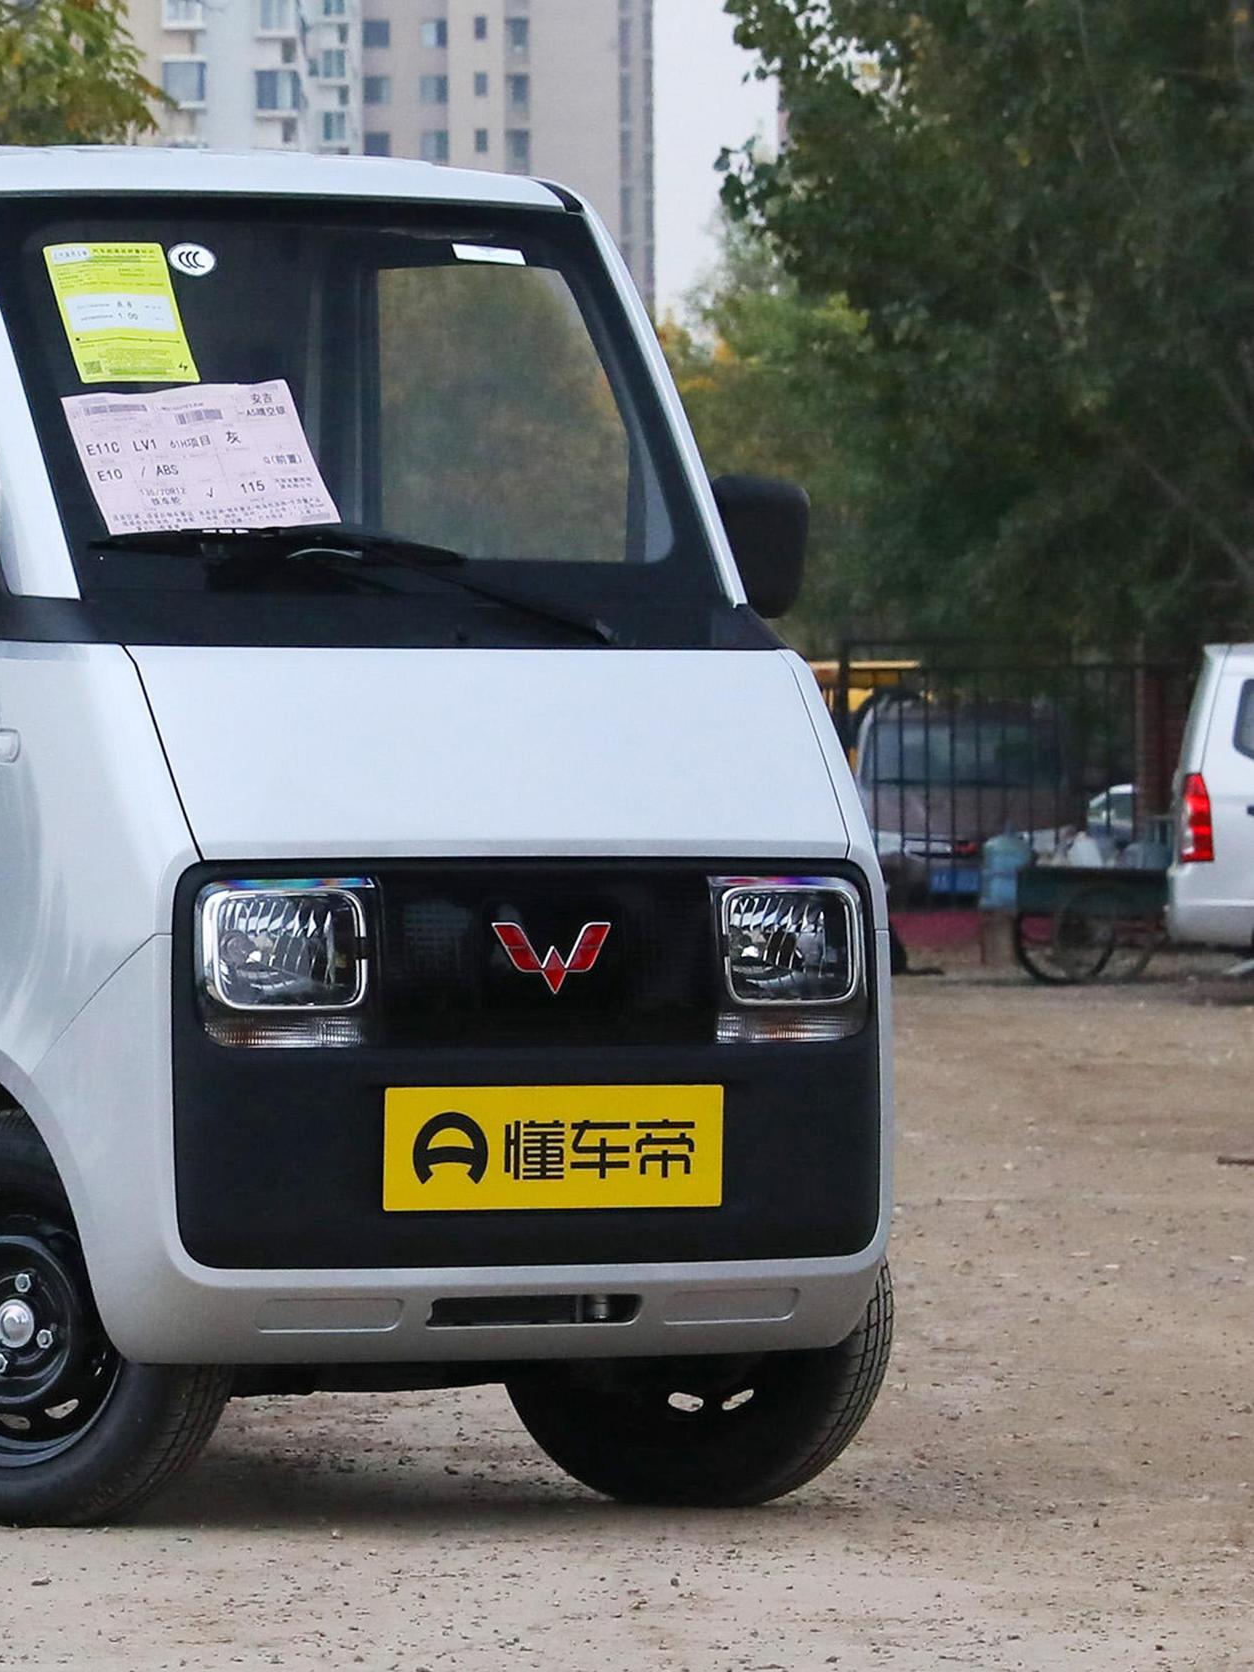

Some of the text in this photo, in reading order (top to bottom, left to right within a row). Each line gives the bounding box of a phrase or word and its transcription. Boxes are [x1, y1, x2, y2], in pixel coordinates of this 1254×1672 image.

[86, 441, 120, 456] E11C
[132, 439, 157, 452] LV1
[97, 468, 123, 482] E10
[156, 464, 179, 477] ABS
[240, 480, 266, 494] 115
[503, 1118, 696, 1181] 懂车帝
